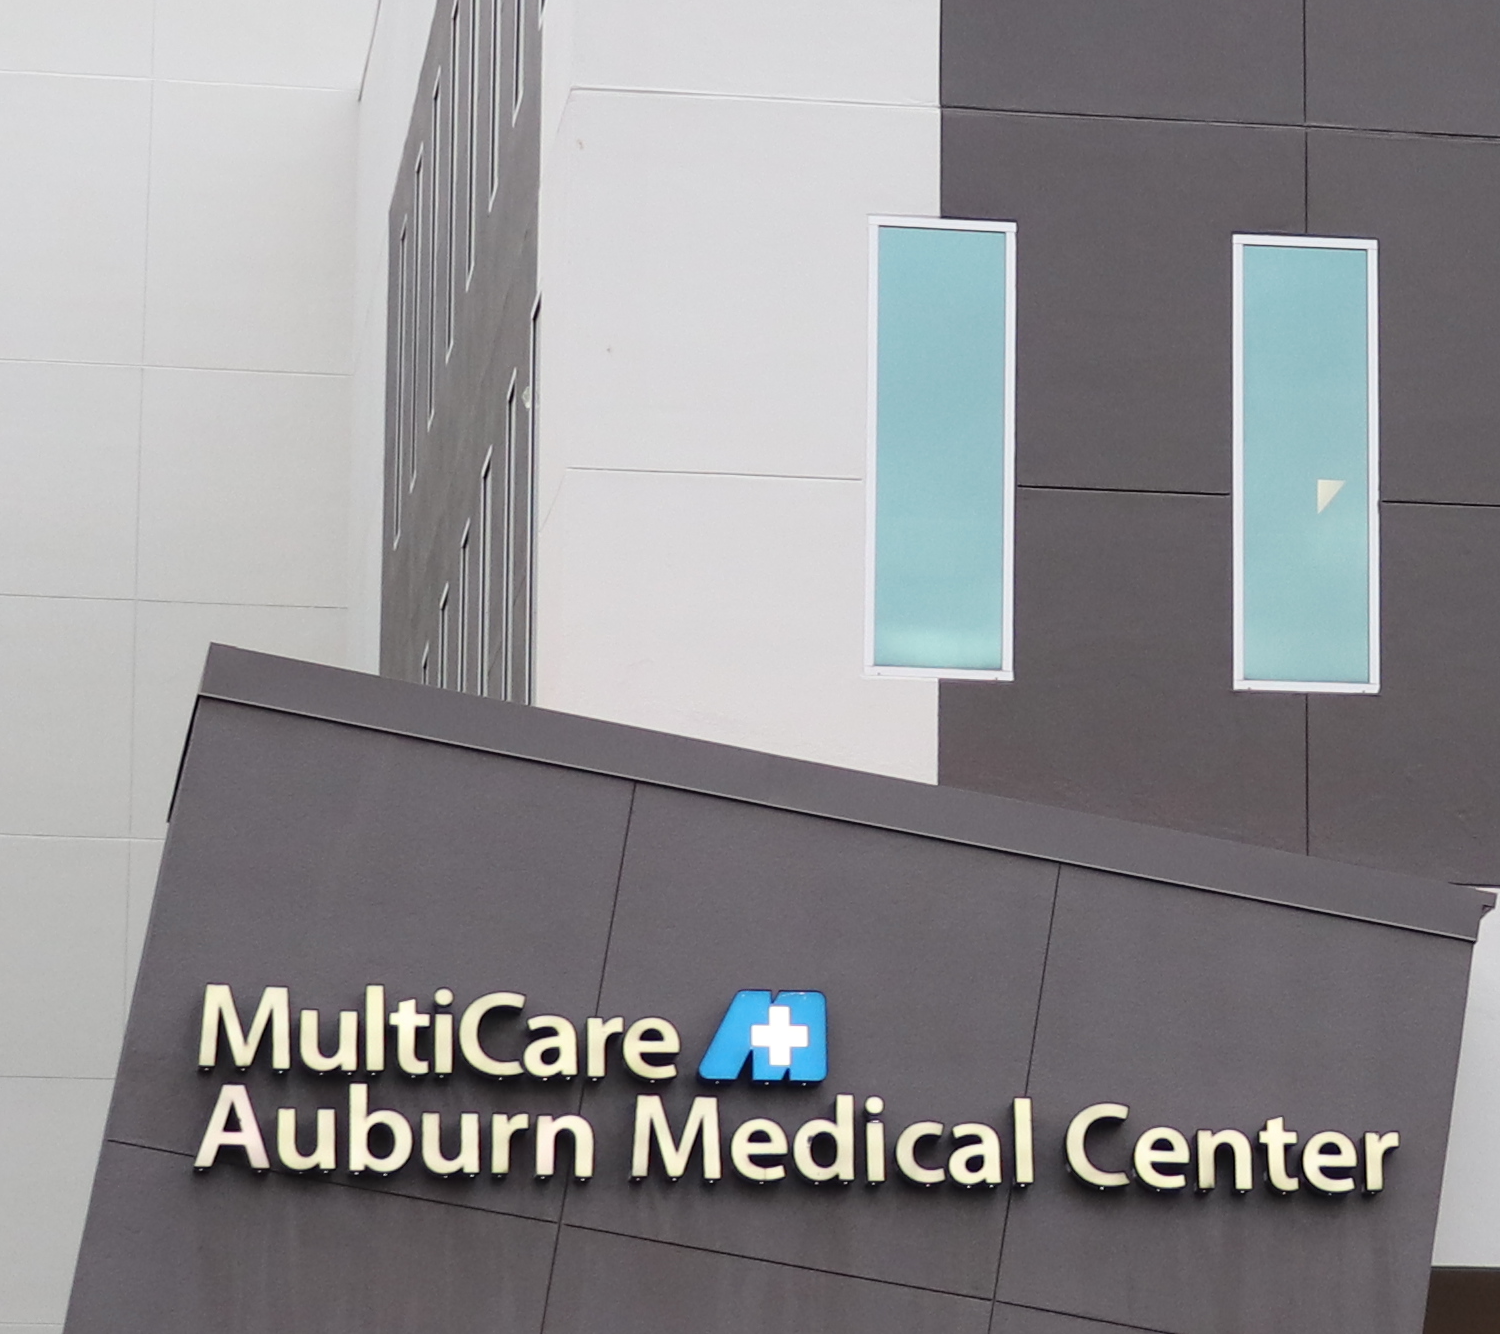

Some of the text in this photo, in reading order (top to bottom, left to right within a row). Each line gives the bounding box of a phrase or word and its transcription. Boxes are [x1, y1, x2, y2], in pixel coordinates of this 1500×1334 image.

[198, 982, 682, 1081] MultiCare
[194, 1082, 1401, 1194] Auburn Medical Center
